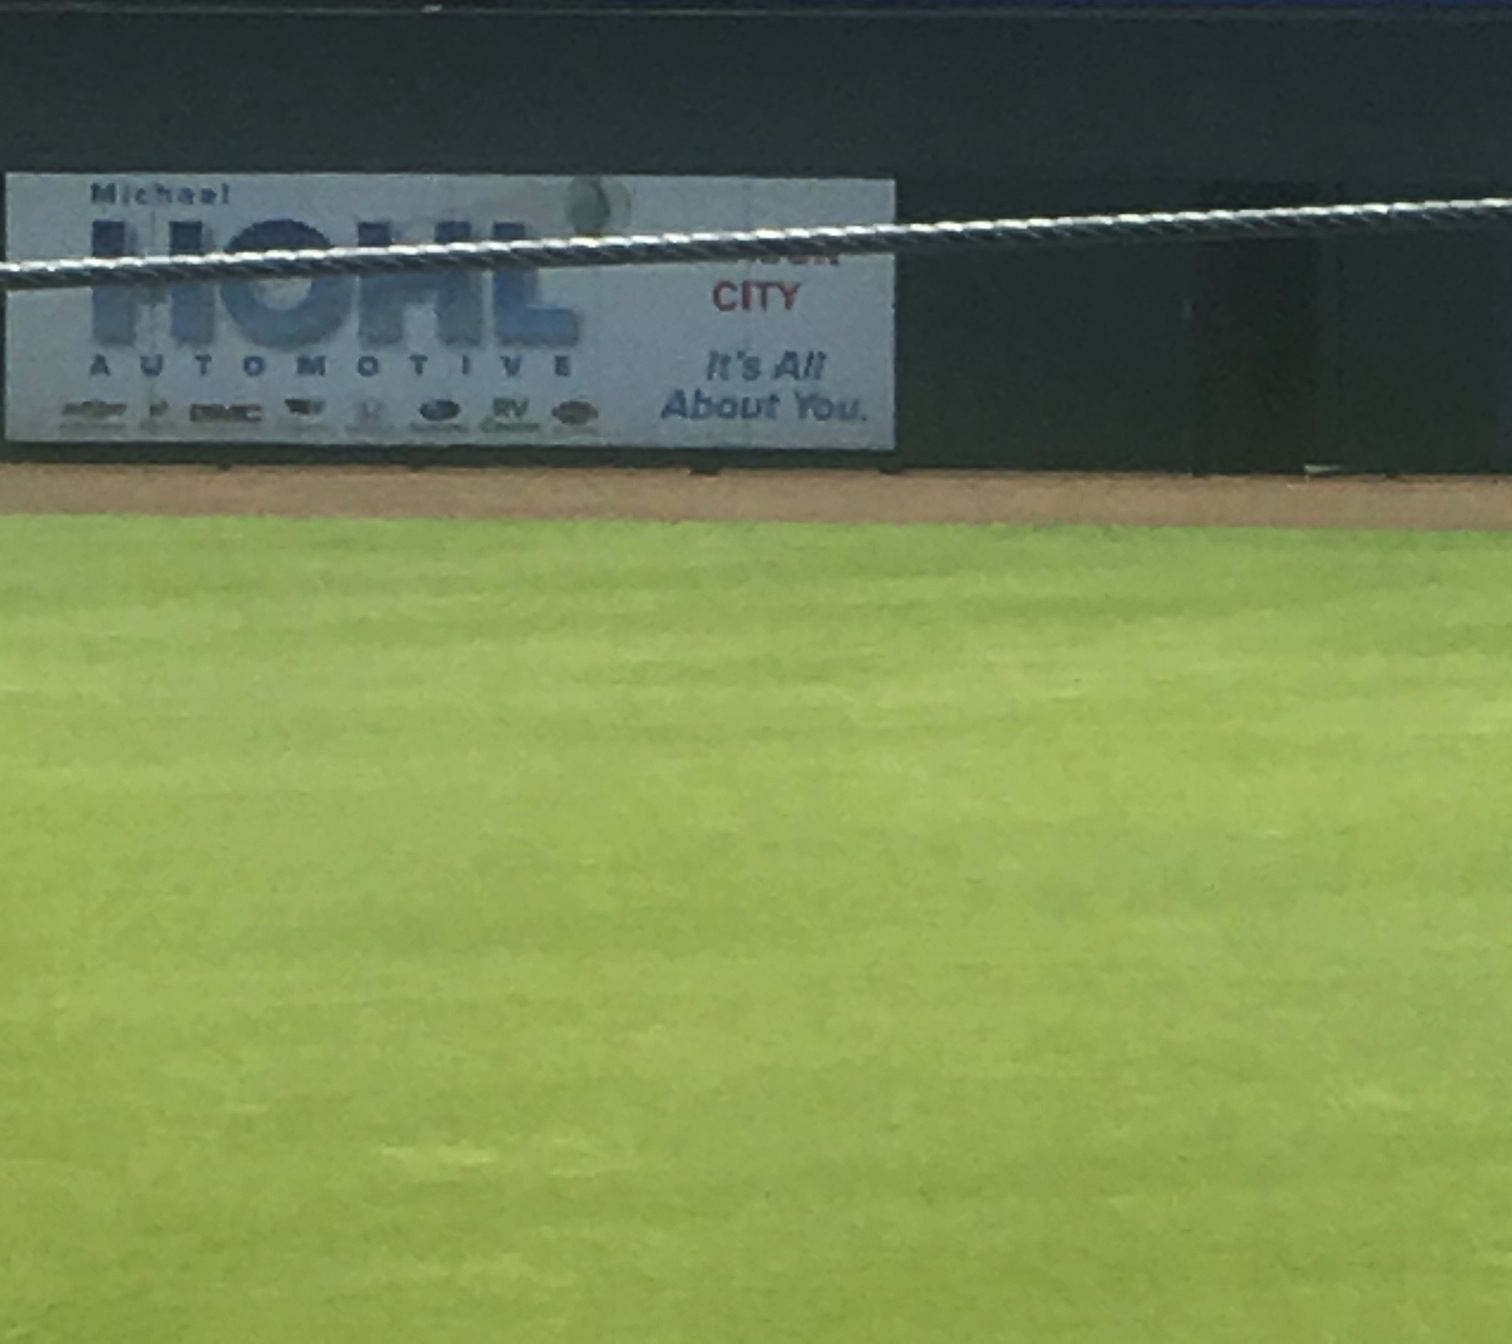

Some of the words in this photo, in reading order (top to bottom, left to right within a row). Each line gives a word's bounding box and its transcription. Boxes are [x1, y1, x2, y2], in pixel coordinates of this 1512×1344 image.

[89, 182, 231, 207] Michael
[712, 279, 803, 312] CITY
[88, 354, 571, 378] AUTOMOTIVE
[706, 349, 762, 382] It's
[773, 349, 828, 381] All
[660, 387, 782, 420] About
[793, 388, 868, 422] You.
